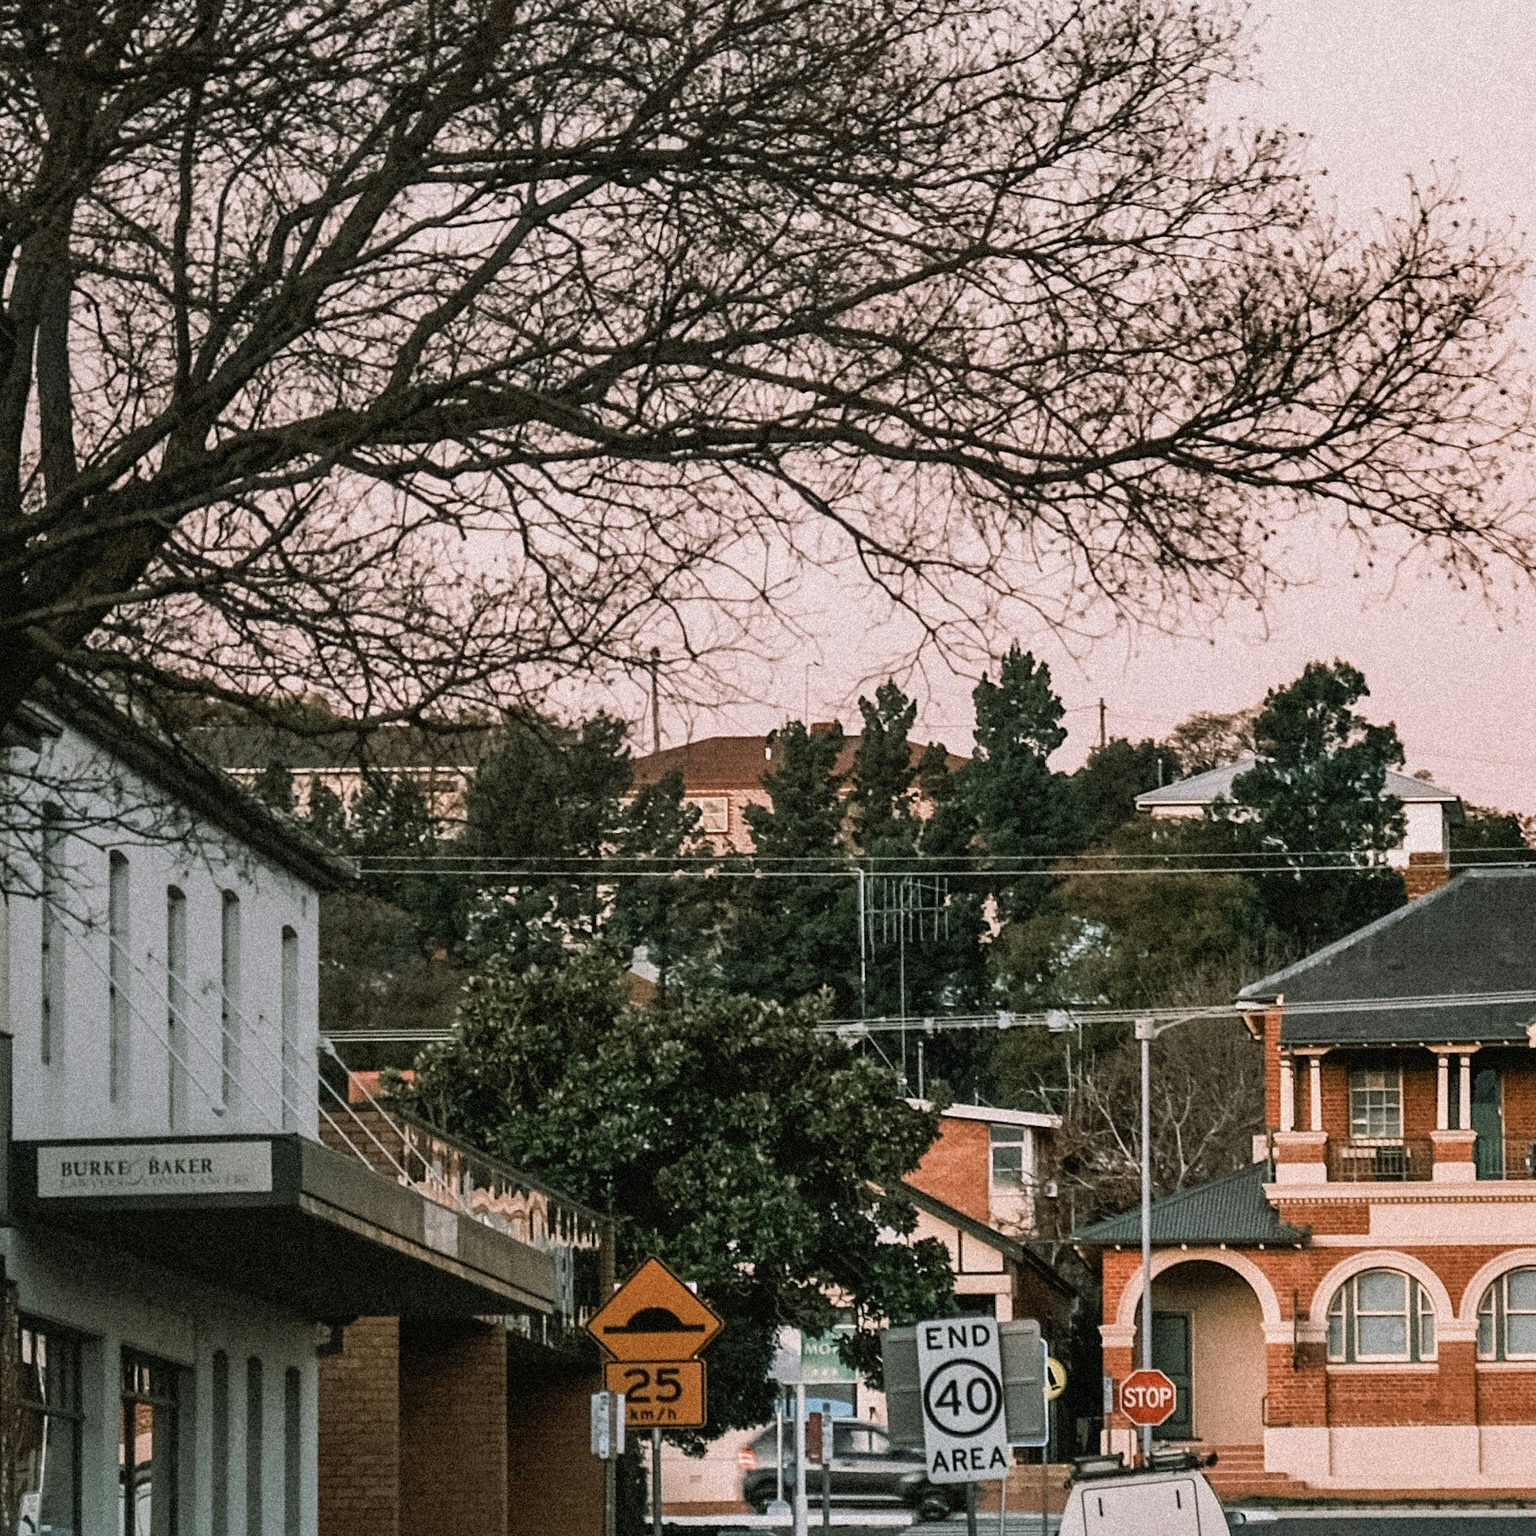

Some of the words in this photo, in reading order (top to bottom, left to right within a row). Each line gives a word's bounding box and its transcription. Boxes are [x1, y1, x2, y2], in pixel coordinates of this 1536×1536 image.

[60, 1159, 129, 1179] BURKE
[148, 1157, 214, 1177] BAKER
[925, 1323, 991, 1351] END
[623, 1367, 683, 1404] 25
[934, 1376, 993, 1417] 40
[1123, 1386, 1173, 1409] STOP
[629, 1406, 678, 1422] km/h
[931, 1445, 1008, 1474] AREA
